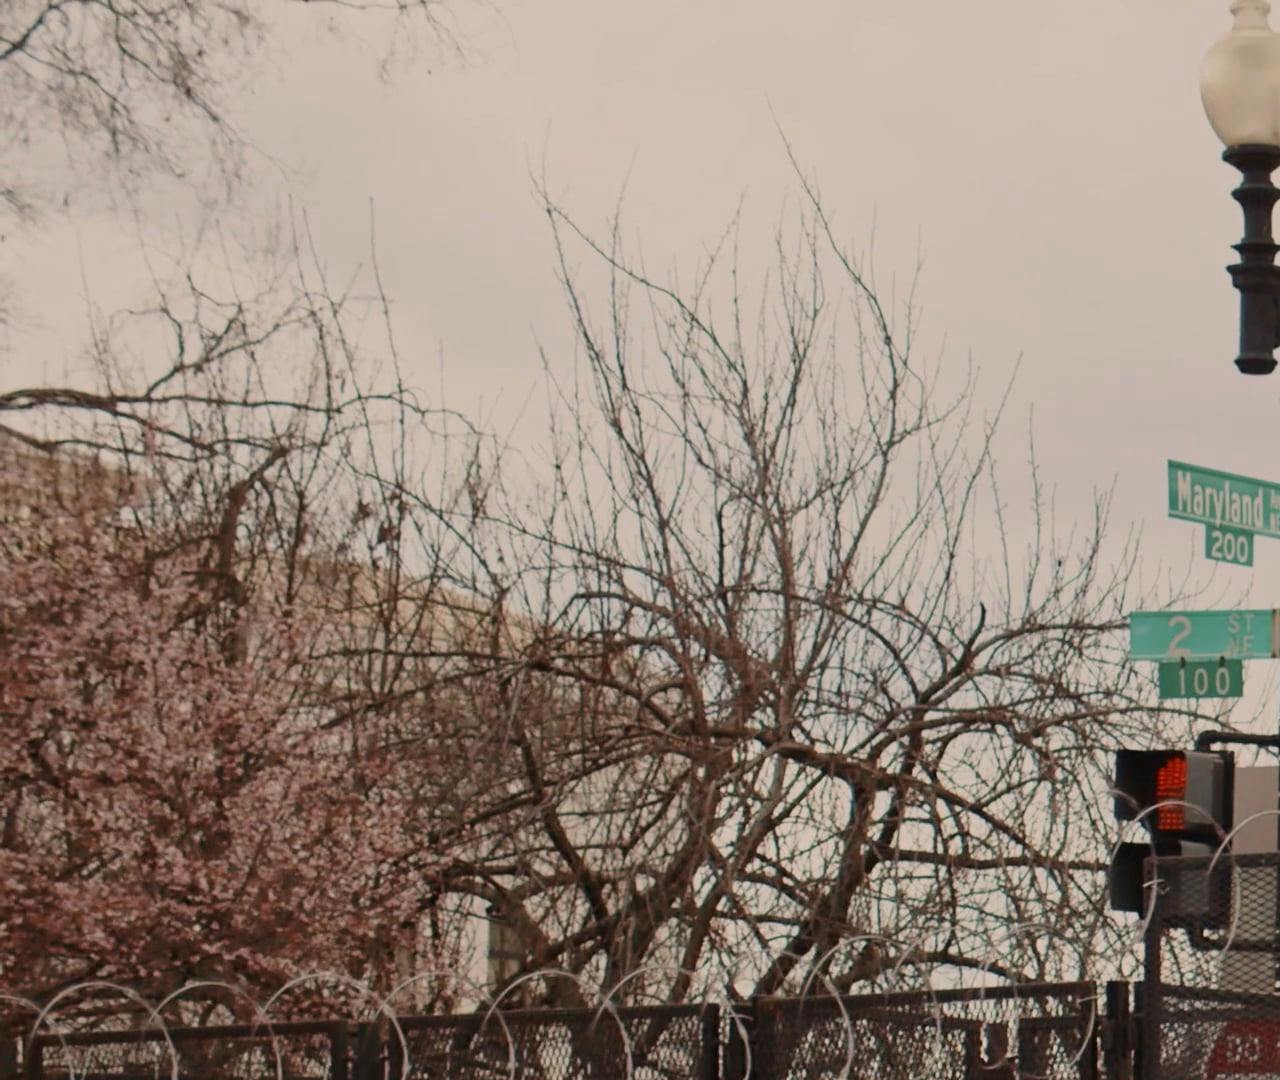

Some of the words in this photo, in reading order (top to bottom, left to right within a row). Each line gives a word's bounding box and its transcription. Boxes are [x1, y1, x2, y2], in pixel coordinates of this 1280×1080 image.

[1178, 471, 1264, 529] Maryland
[1211, 531, 1249, 563] 200
[1168, 616, 1192, 656] 2
[1228, 614, 1254, 634] ST
[1228, 635, 1254, 656] NE
[1178, 668, 1230, 696] 100
[1226, 1035, 1260, 1062] DO
